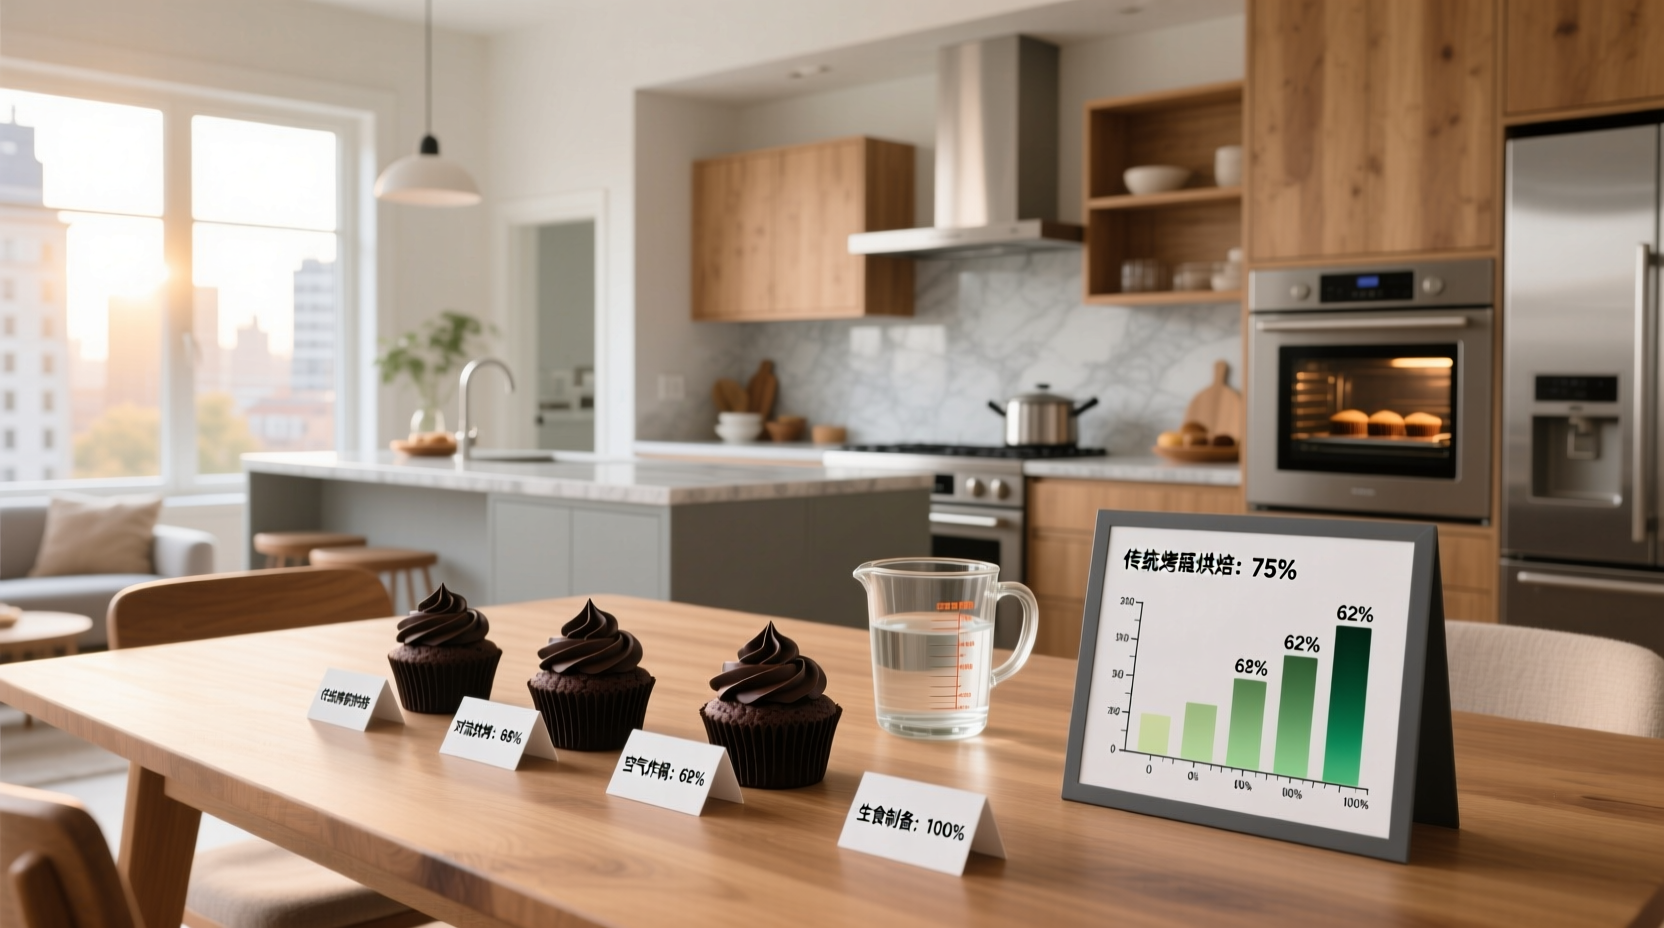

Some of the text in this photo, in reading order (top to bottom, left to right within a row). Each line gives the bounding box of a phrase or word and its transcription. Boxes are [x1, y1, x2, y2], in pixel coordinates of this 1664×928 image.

[1252, 557, 1297, 580] 75%
[1336, 604, 1374, 623] 62%
[1284, 634, 1320, 653] 62%
[1110, 744, 1116, 754] 0
[1146, 764, 1152, 774] 0
[927, 818, 965, 841] 100%
